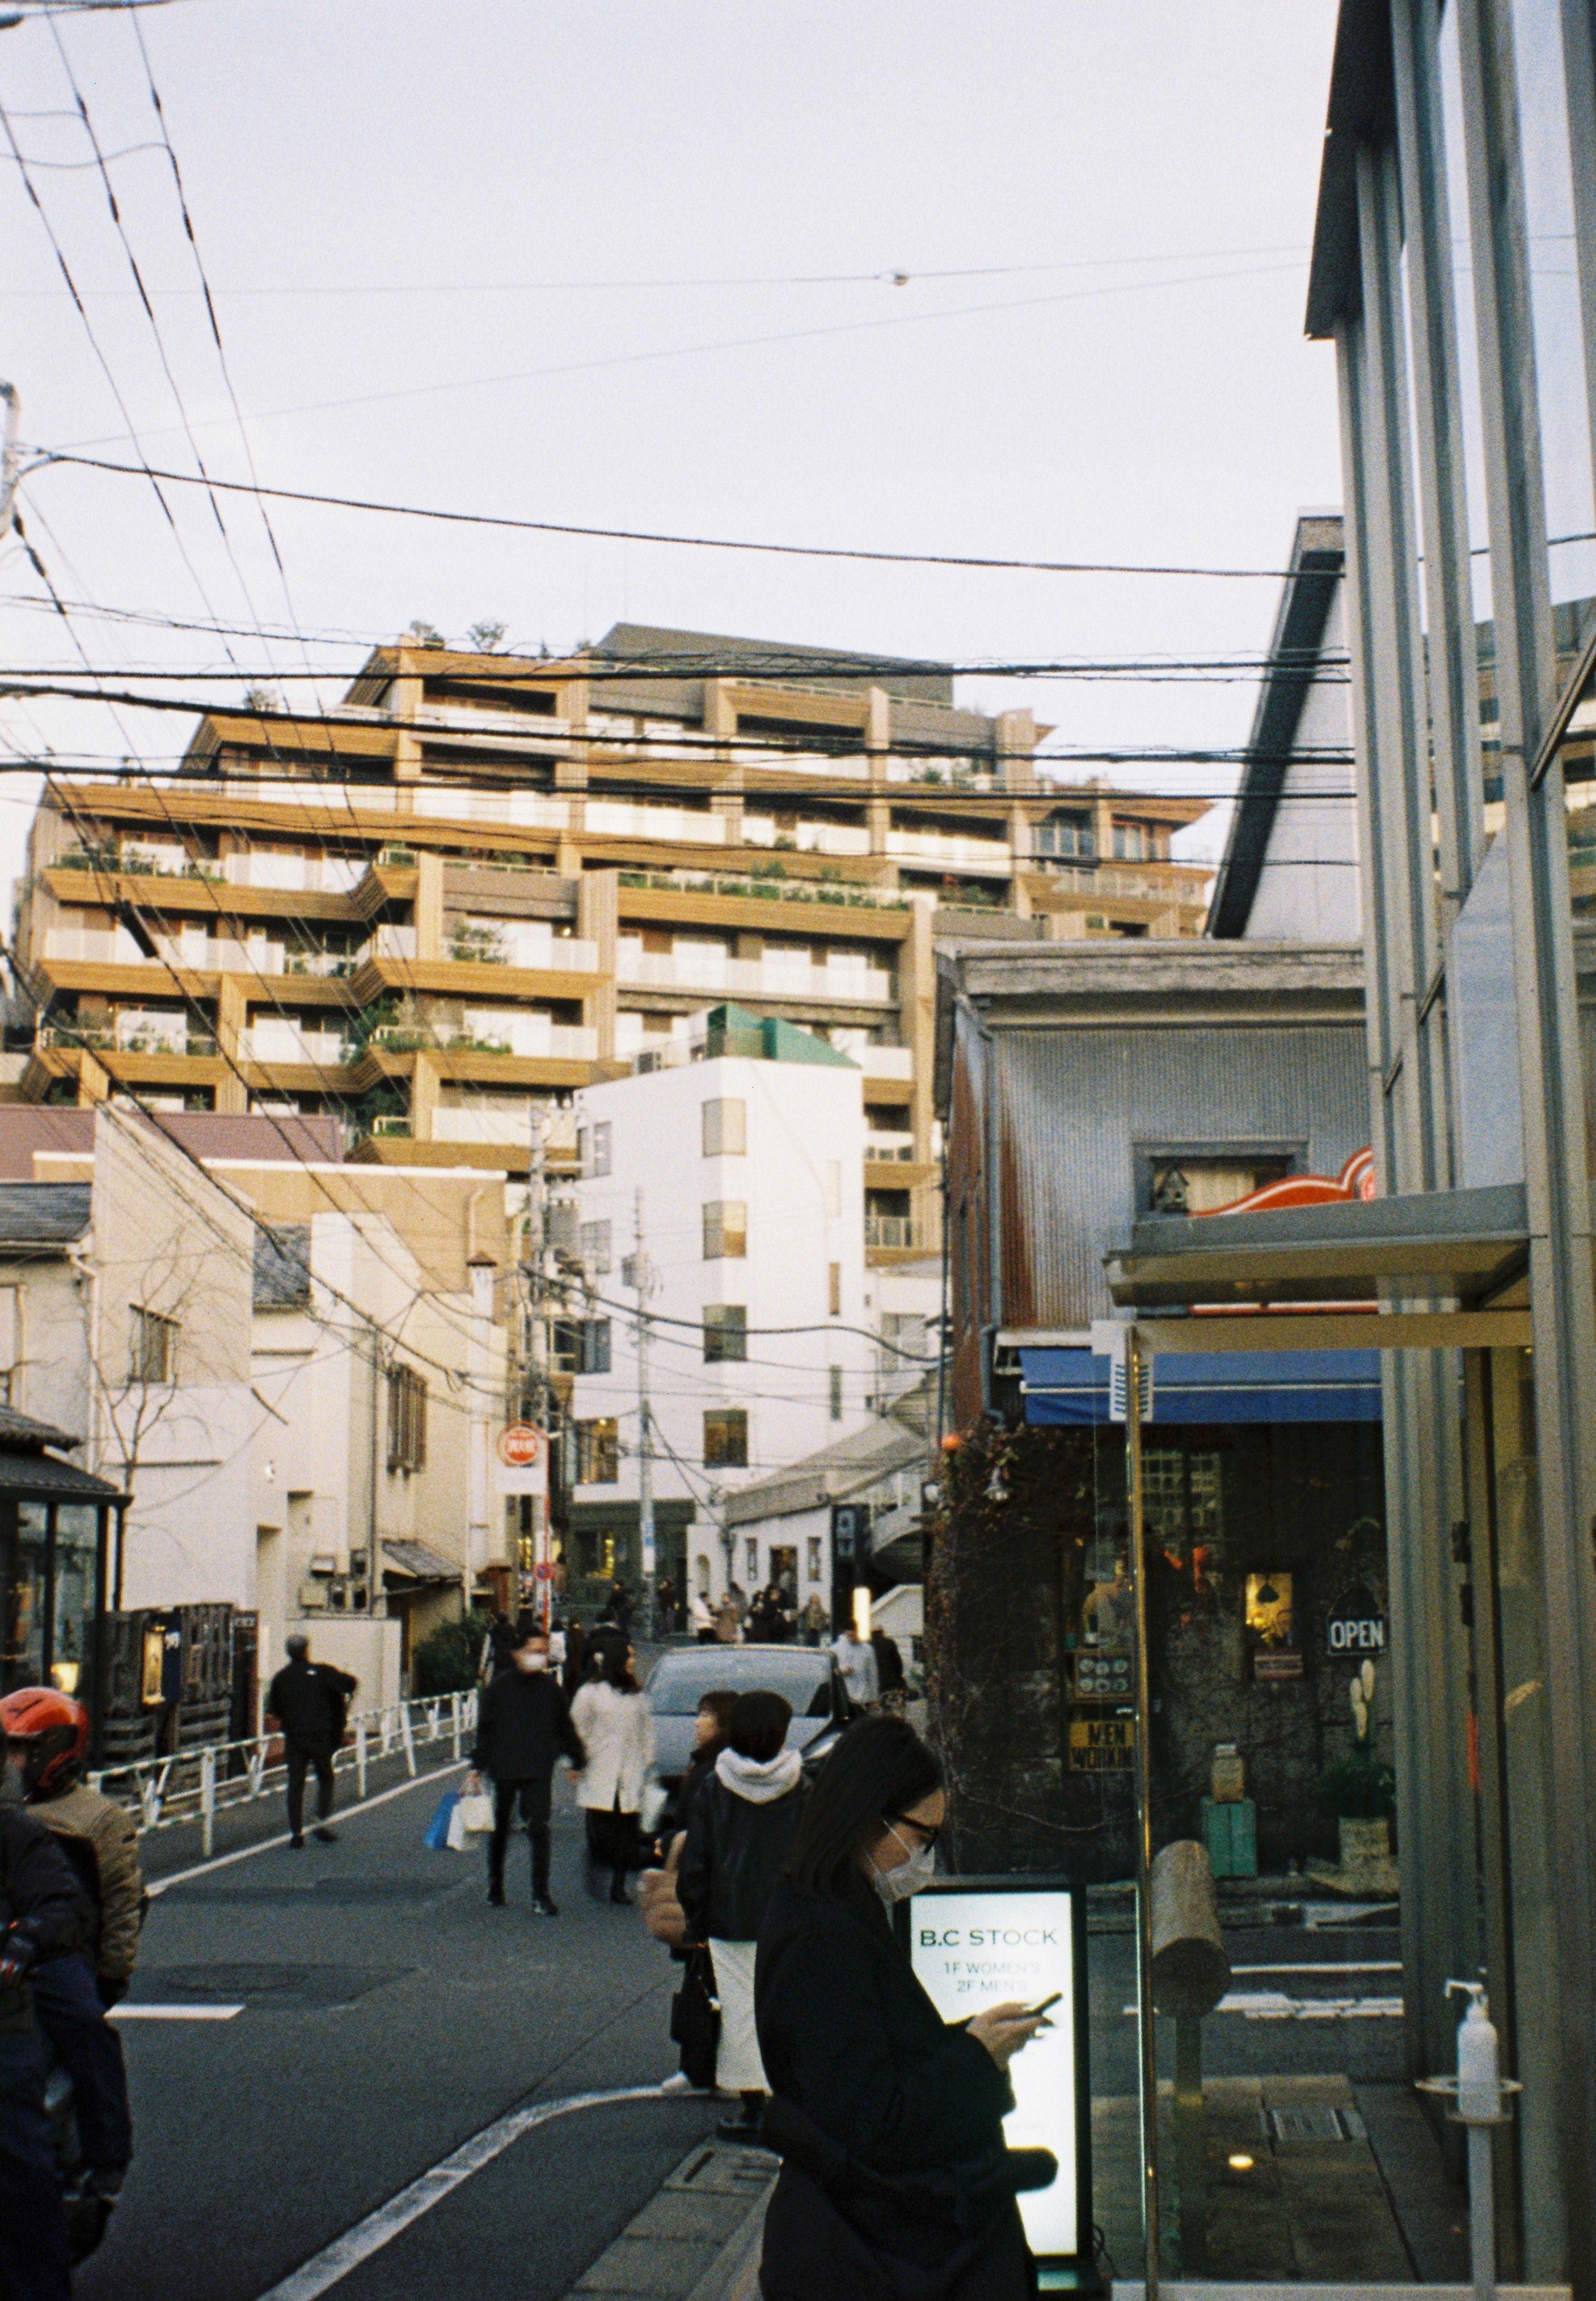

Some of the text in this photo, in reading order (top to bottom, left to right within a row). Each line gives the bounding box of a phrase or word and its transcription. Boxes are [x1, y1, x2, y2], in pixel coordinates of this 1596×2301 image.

[1330, 1620, 1384, 1648] OPEN
[920, 1929, 1058, 1947] B.C STOCK
[944, 1961, 1040, 1975] 1F WOMEN'S
[957, 1979, 1028, 1993] 2F MEN'S
